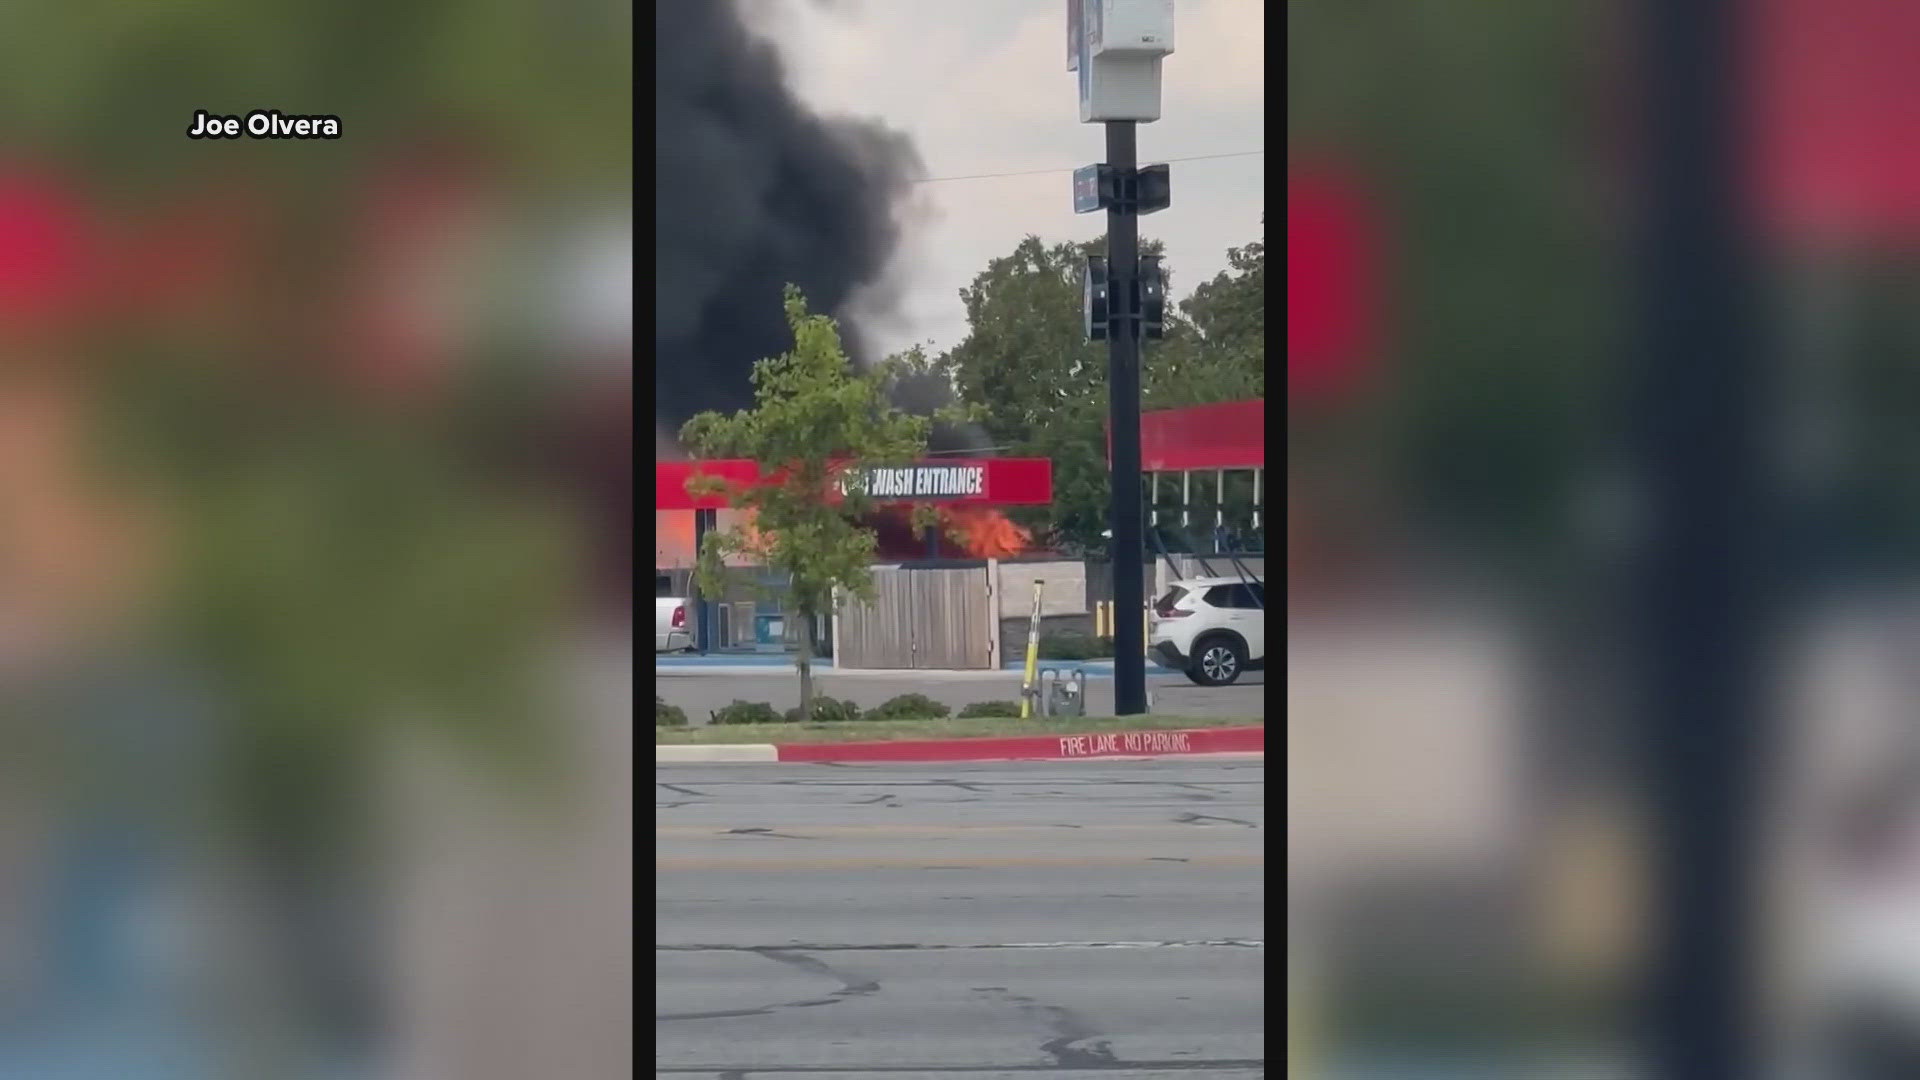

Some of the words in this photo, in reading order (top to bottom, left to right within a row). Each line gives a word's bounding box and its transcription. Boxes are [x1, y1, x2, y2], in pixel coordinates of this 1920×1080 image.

[872, 467, 914, 497] WASH
[915, 466, 984, 496] ENTRANCE
[1060, 736, 1087, 757] FIRE
[1090, 733, 1119, 754] LANE
[1124, 733, 1140, 753] NO
[1143, 732, 1191, 753] PARKING
